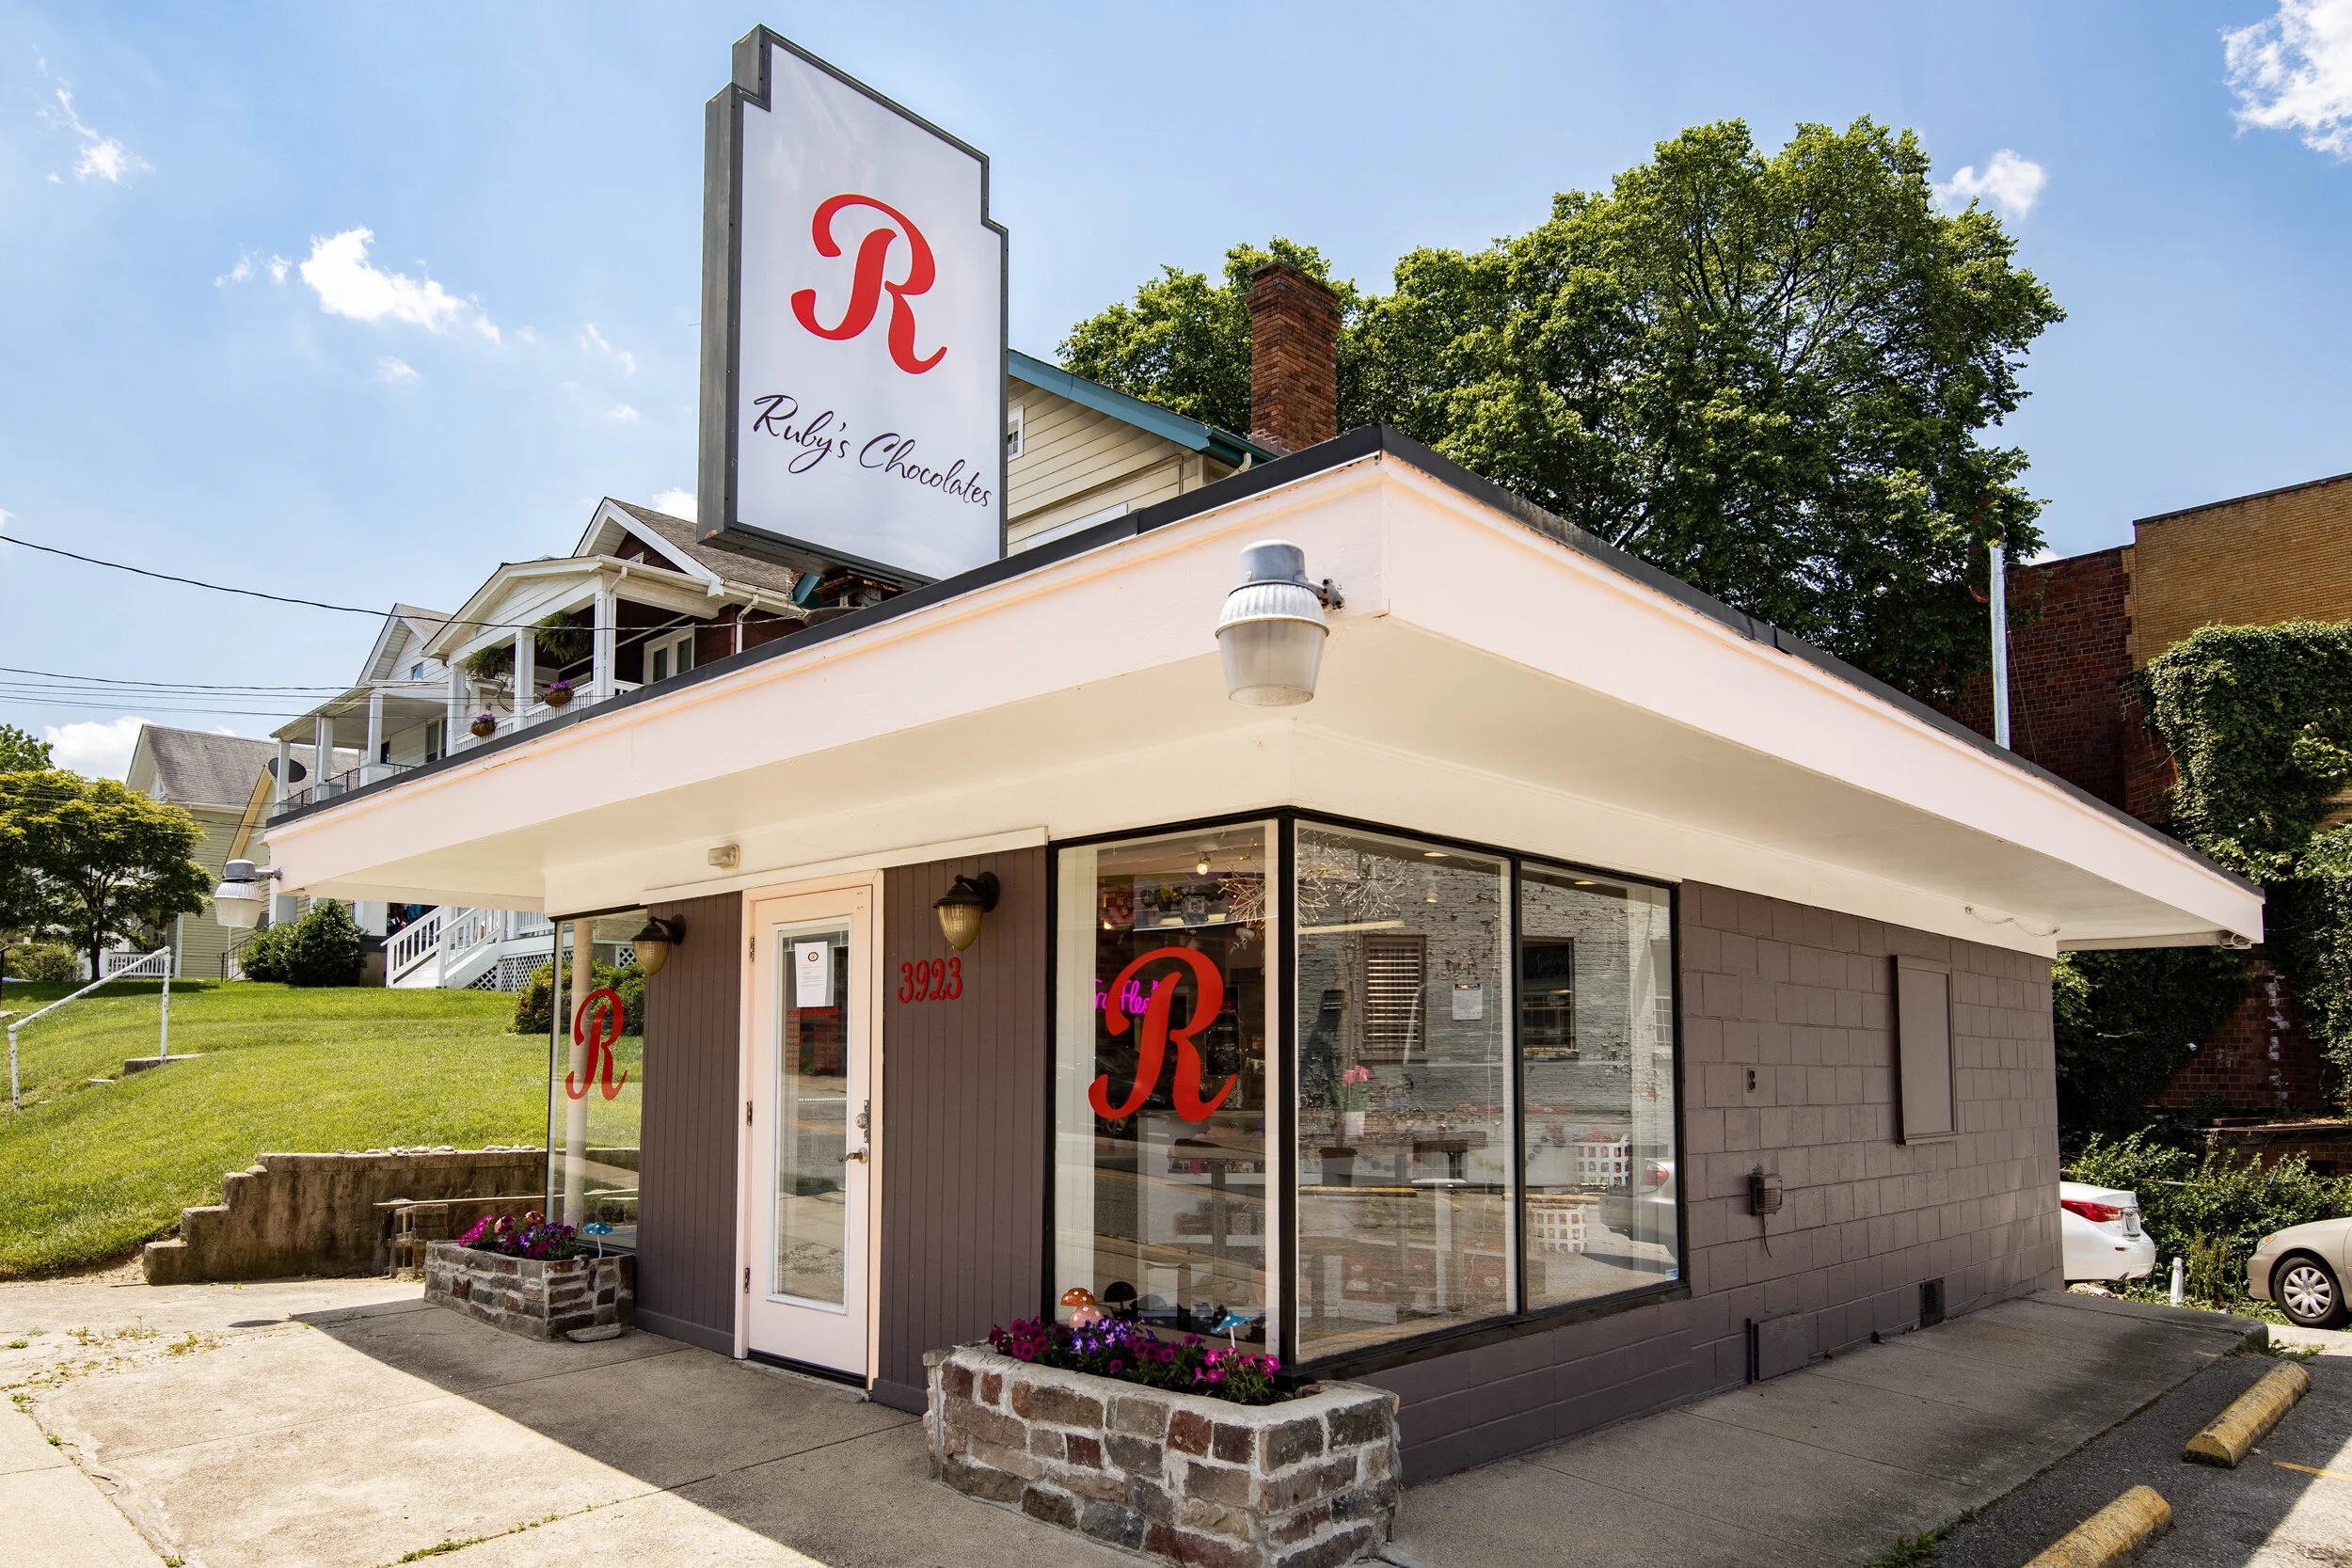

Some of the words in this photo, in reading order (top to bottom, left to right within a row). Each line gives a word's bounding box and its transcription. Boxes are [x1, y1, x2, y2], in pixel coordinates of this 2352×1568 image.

[791, 194, 947, 374] R
[754, 394, 850, 474] Ruby's
[859, 433, 993, 507] Chocolates
[898, 957, 962, 1004] 3923
[1089, 946, 1237, 1122] R
[565, 988, 628, 1101] R
